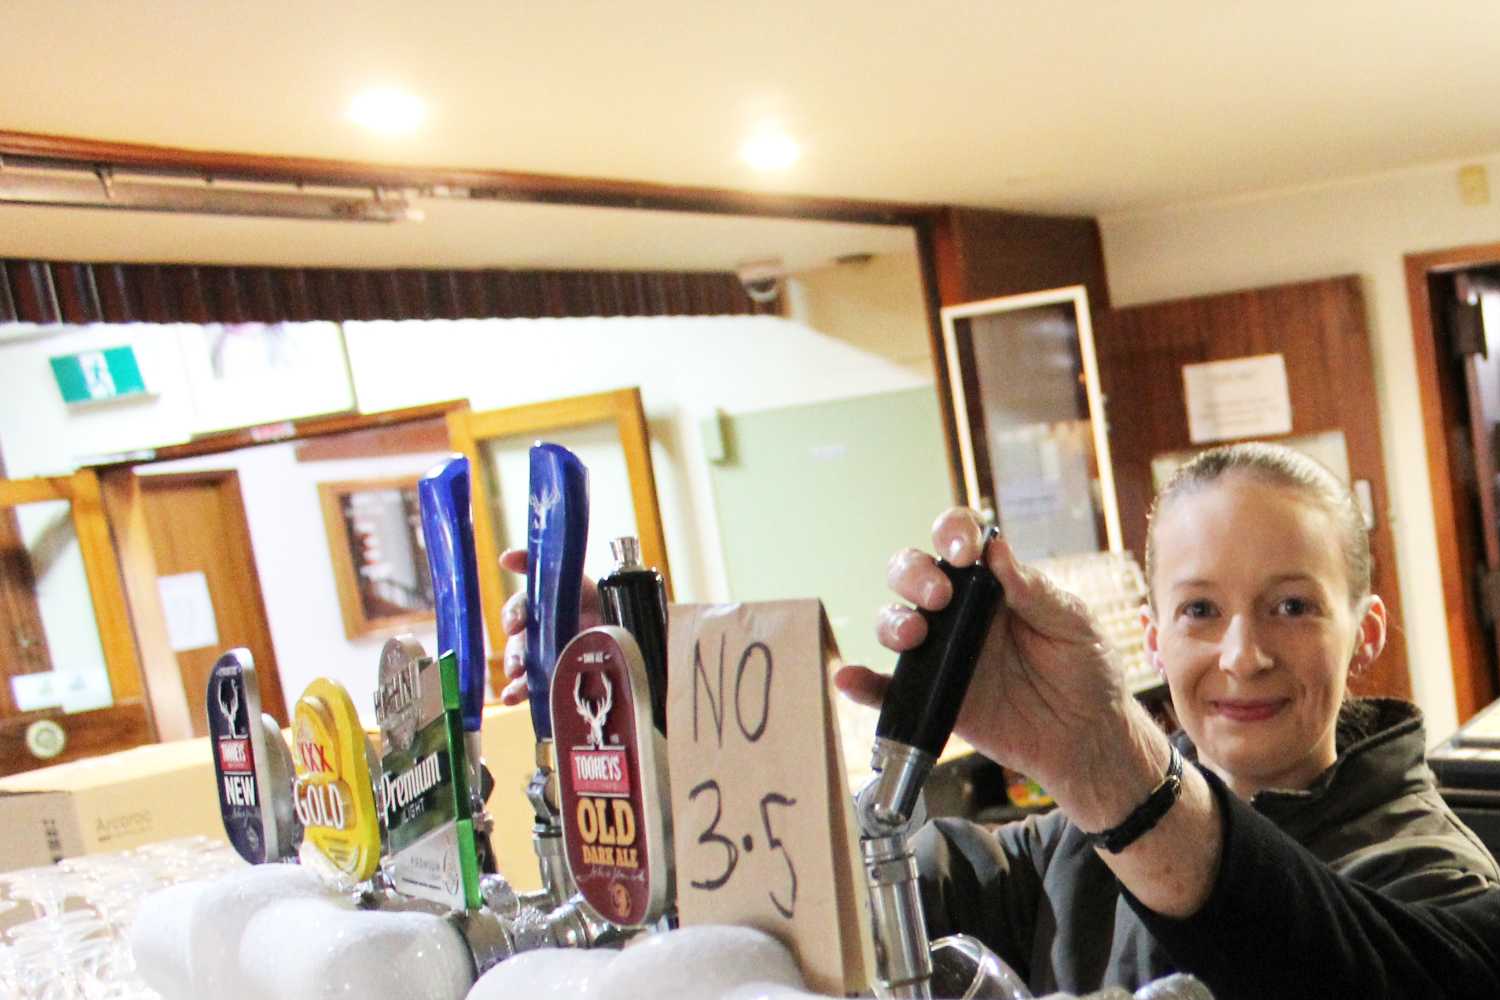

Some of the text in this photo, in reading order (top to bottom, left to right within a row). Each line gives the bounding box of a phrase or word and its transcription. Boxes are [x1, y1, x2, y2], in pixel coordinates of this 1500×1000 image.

[693, 632, 773, 748] NO
[223, 775, 256, 807] NEW
[382, 751, 443, 827] Premium
[574, 754, 623, 781] TOOHEYS
[294, 779, 345, 831] GOLD
[402, 798, 426, 824] LIGHT
[577, 798, 636, 846] OLD
[582, 845, 638, 869] DARK ALE
[689, 779, 798, 919] 3.5
